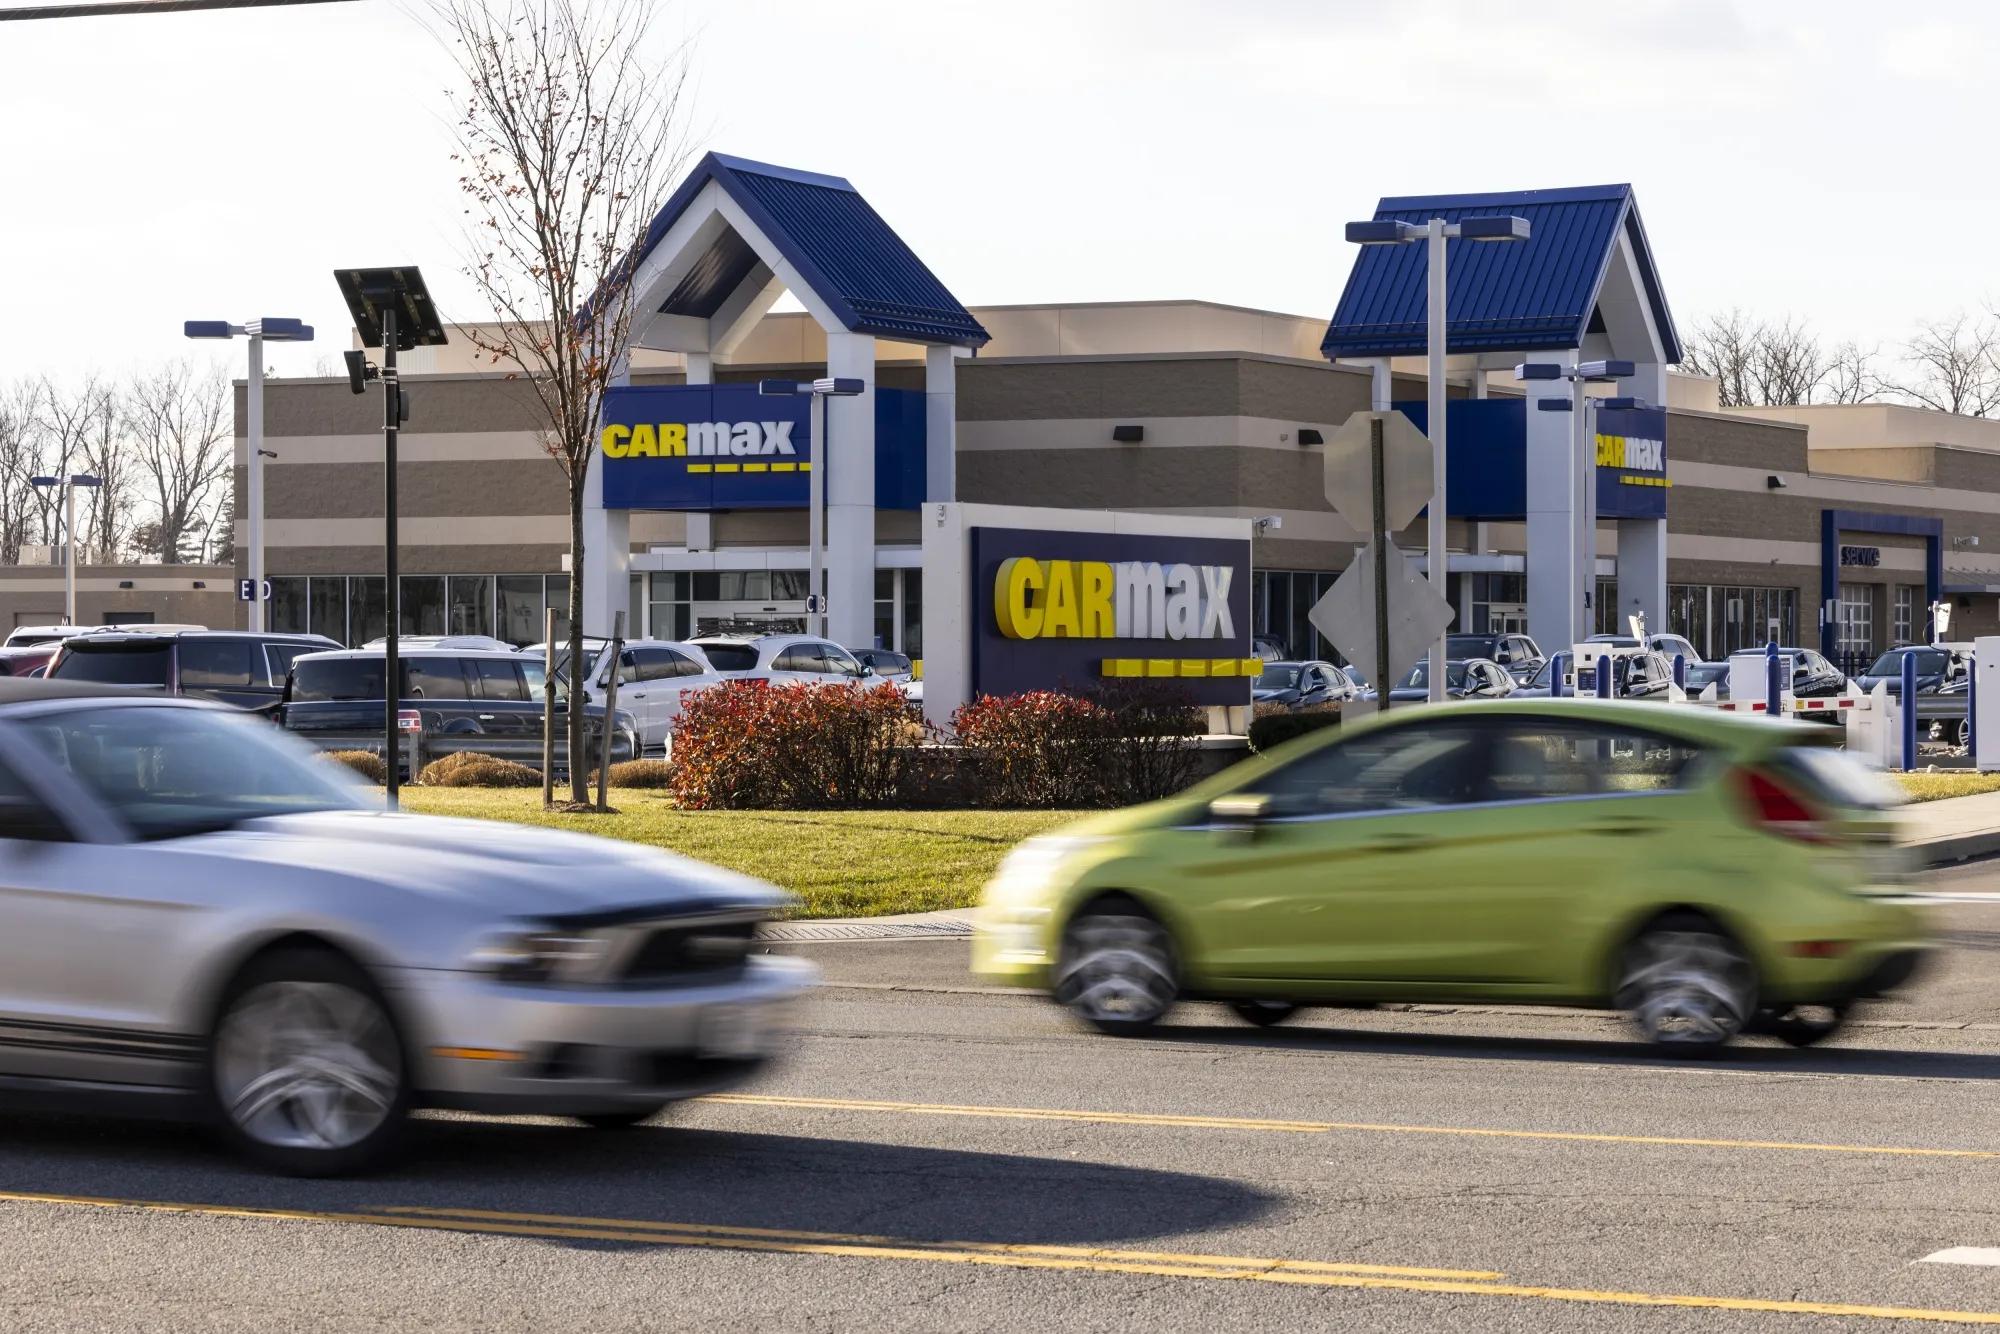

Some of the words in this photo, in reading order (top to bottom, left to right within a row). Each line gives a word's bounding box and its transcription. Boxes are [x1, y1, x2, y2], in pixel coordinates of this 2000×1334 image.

[602, 421, 796, 458] CARmax
[1595, 433, 1663, 471] CARmax
[1842, 546, 1880, 566] service
[241, 580, 250, 600] E
[806, 595, 814, 613] C
[995, 557, 1236, 640] CARmax
